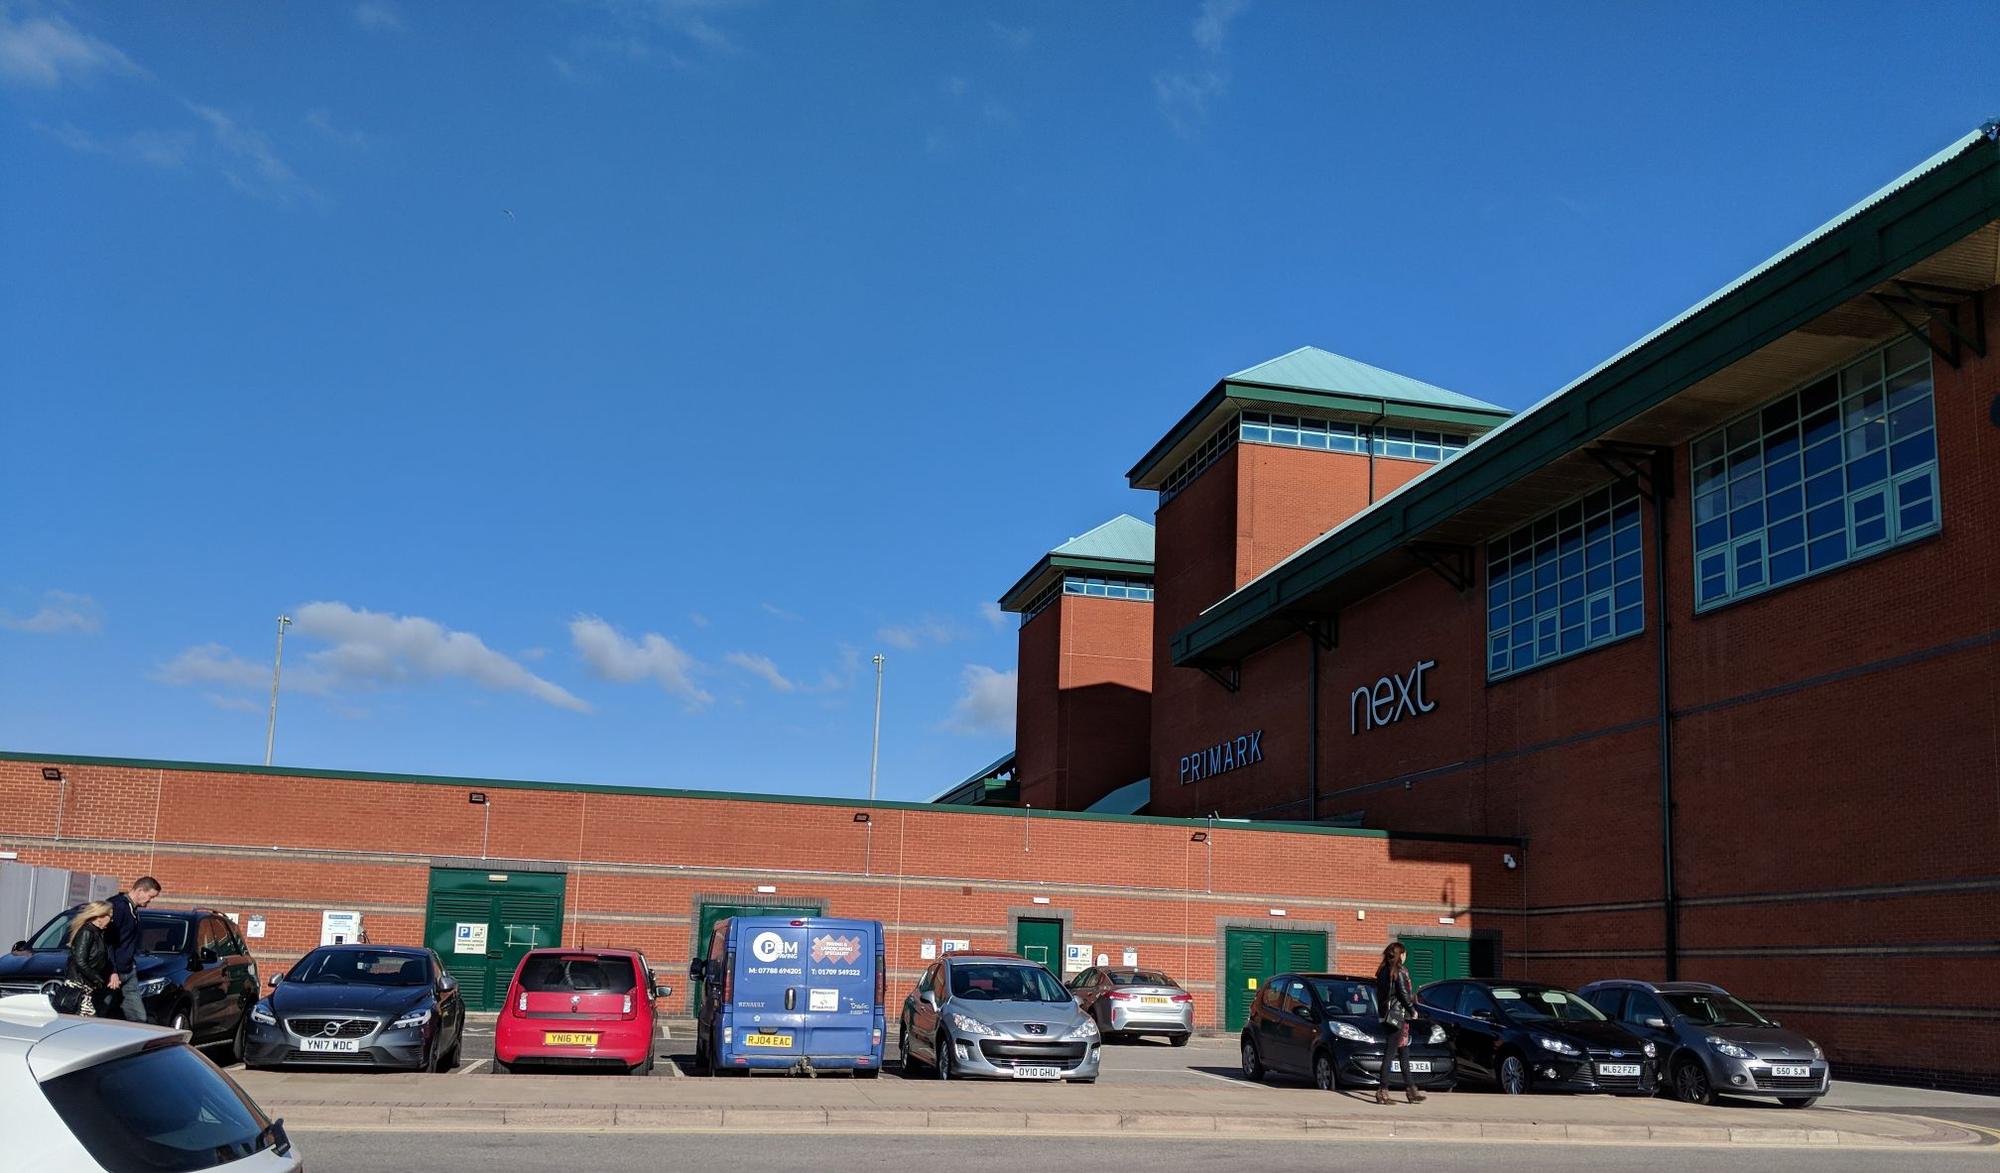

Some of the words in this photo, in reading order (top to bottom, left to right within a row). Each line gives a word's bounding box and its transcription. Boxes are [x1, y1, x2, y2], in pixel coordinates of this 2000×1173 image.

[1351, 660, 1436, 735] next
[1179, 729, 1264, 785] PRIMARK
[551, 1034, 572, 1042] YN16
[574, 1034, 592, 1043] YTM
[748, 1035, 771, 1045] RJ04
[773, 1036, 791, 1046] EAC
[307, 1040, 330, 1050] YN17
[332, 1040, 353, 1051] WDC
[1019, 1067, 1038, 1076] OY10
[1039, 1068, 1056, 1077] GHU
[1602, 1065, 1622, 1074] ML62
[1623, 1066, 1638, 1074] FZF
